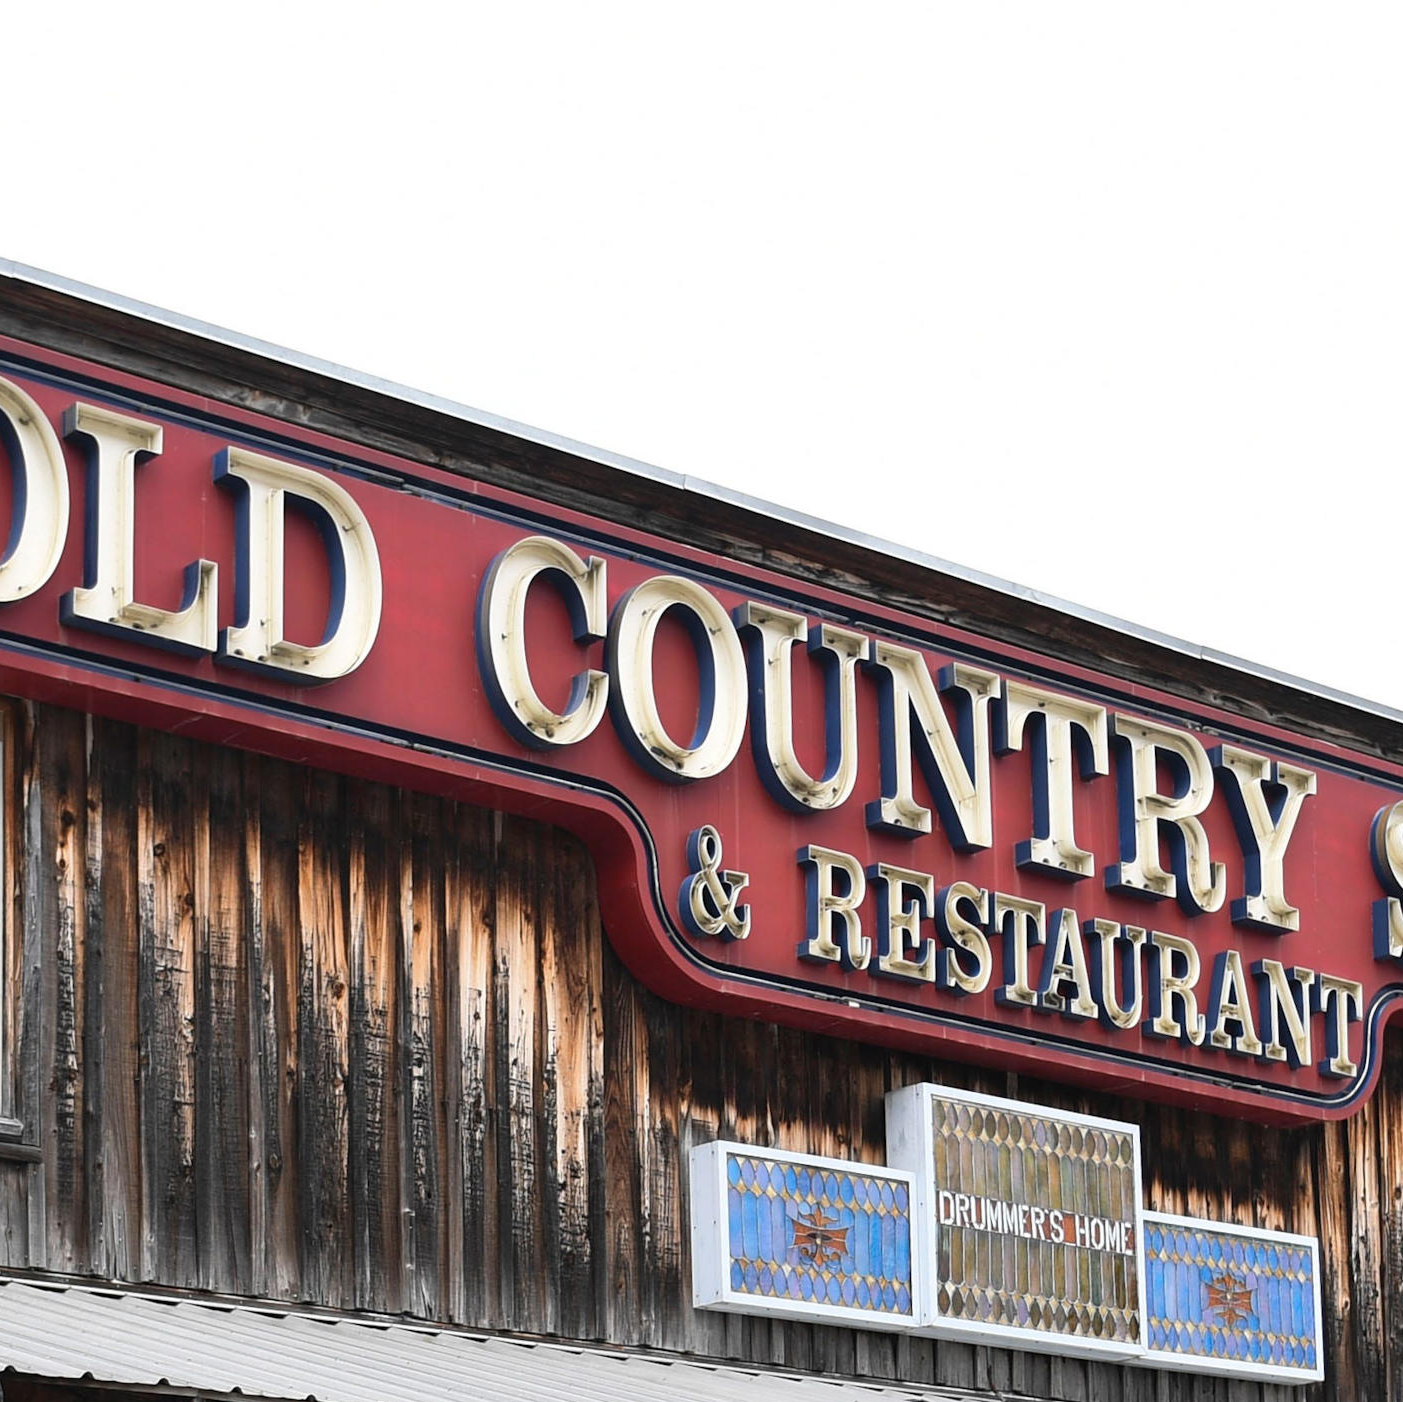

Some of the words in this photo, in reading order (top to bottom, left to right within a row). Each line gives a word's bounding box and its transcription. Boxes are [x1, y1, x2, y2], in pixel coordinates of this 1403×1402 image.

[475, 535, 1317, 934] COUNTRY
[677, 824, 751, 942] &
[797, 844, 1363, 1080] RESTAURANT
[939, 1190, 1065, 1244] DRUMMER'S
[1075, 1214, 1134, 1255] HOME
